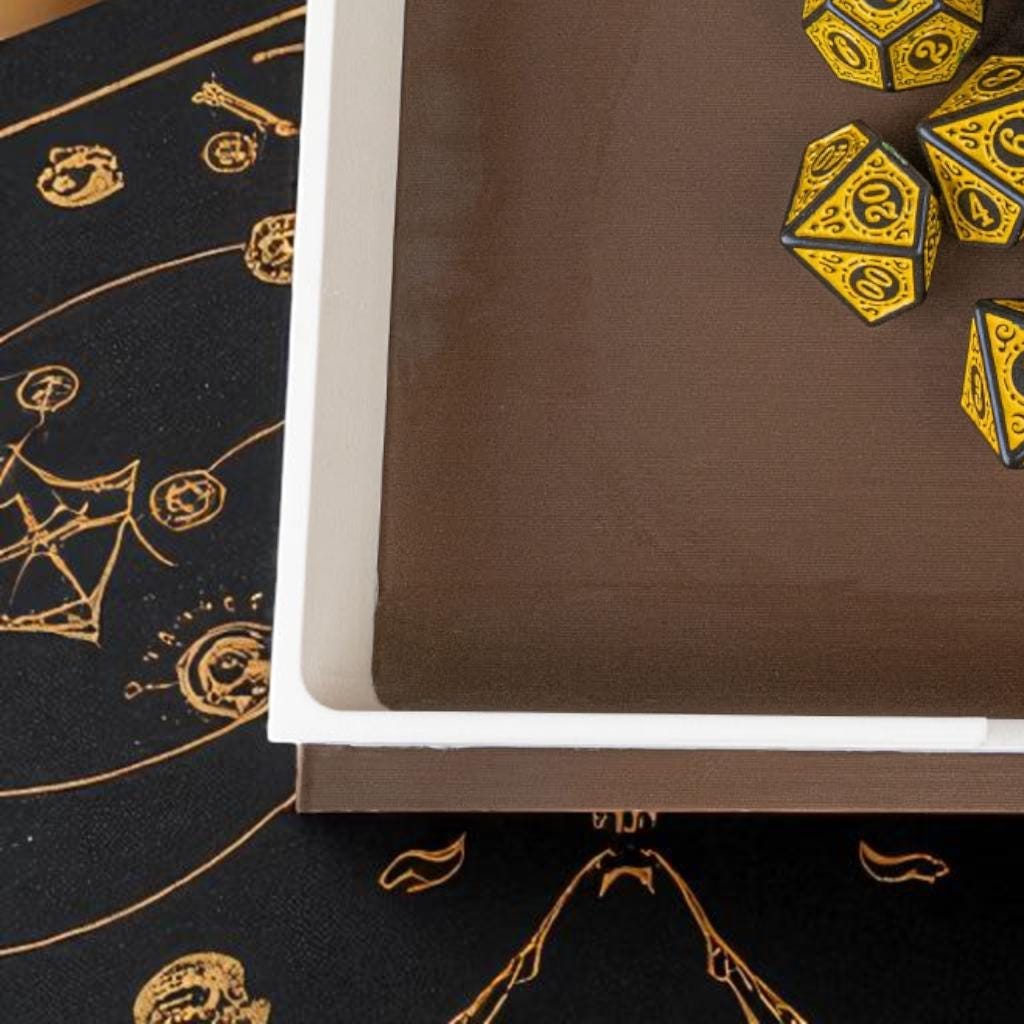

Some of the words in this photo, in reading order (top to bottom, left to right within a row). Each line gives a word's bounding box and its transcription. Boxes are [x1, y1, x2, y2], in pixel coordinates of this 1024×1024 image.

[915, 40, 948, 64] 2
[858, 183, 899, 223] 20
[968, 191, 995, 228] 4
[856, 267, 893, 300] 00
